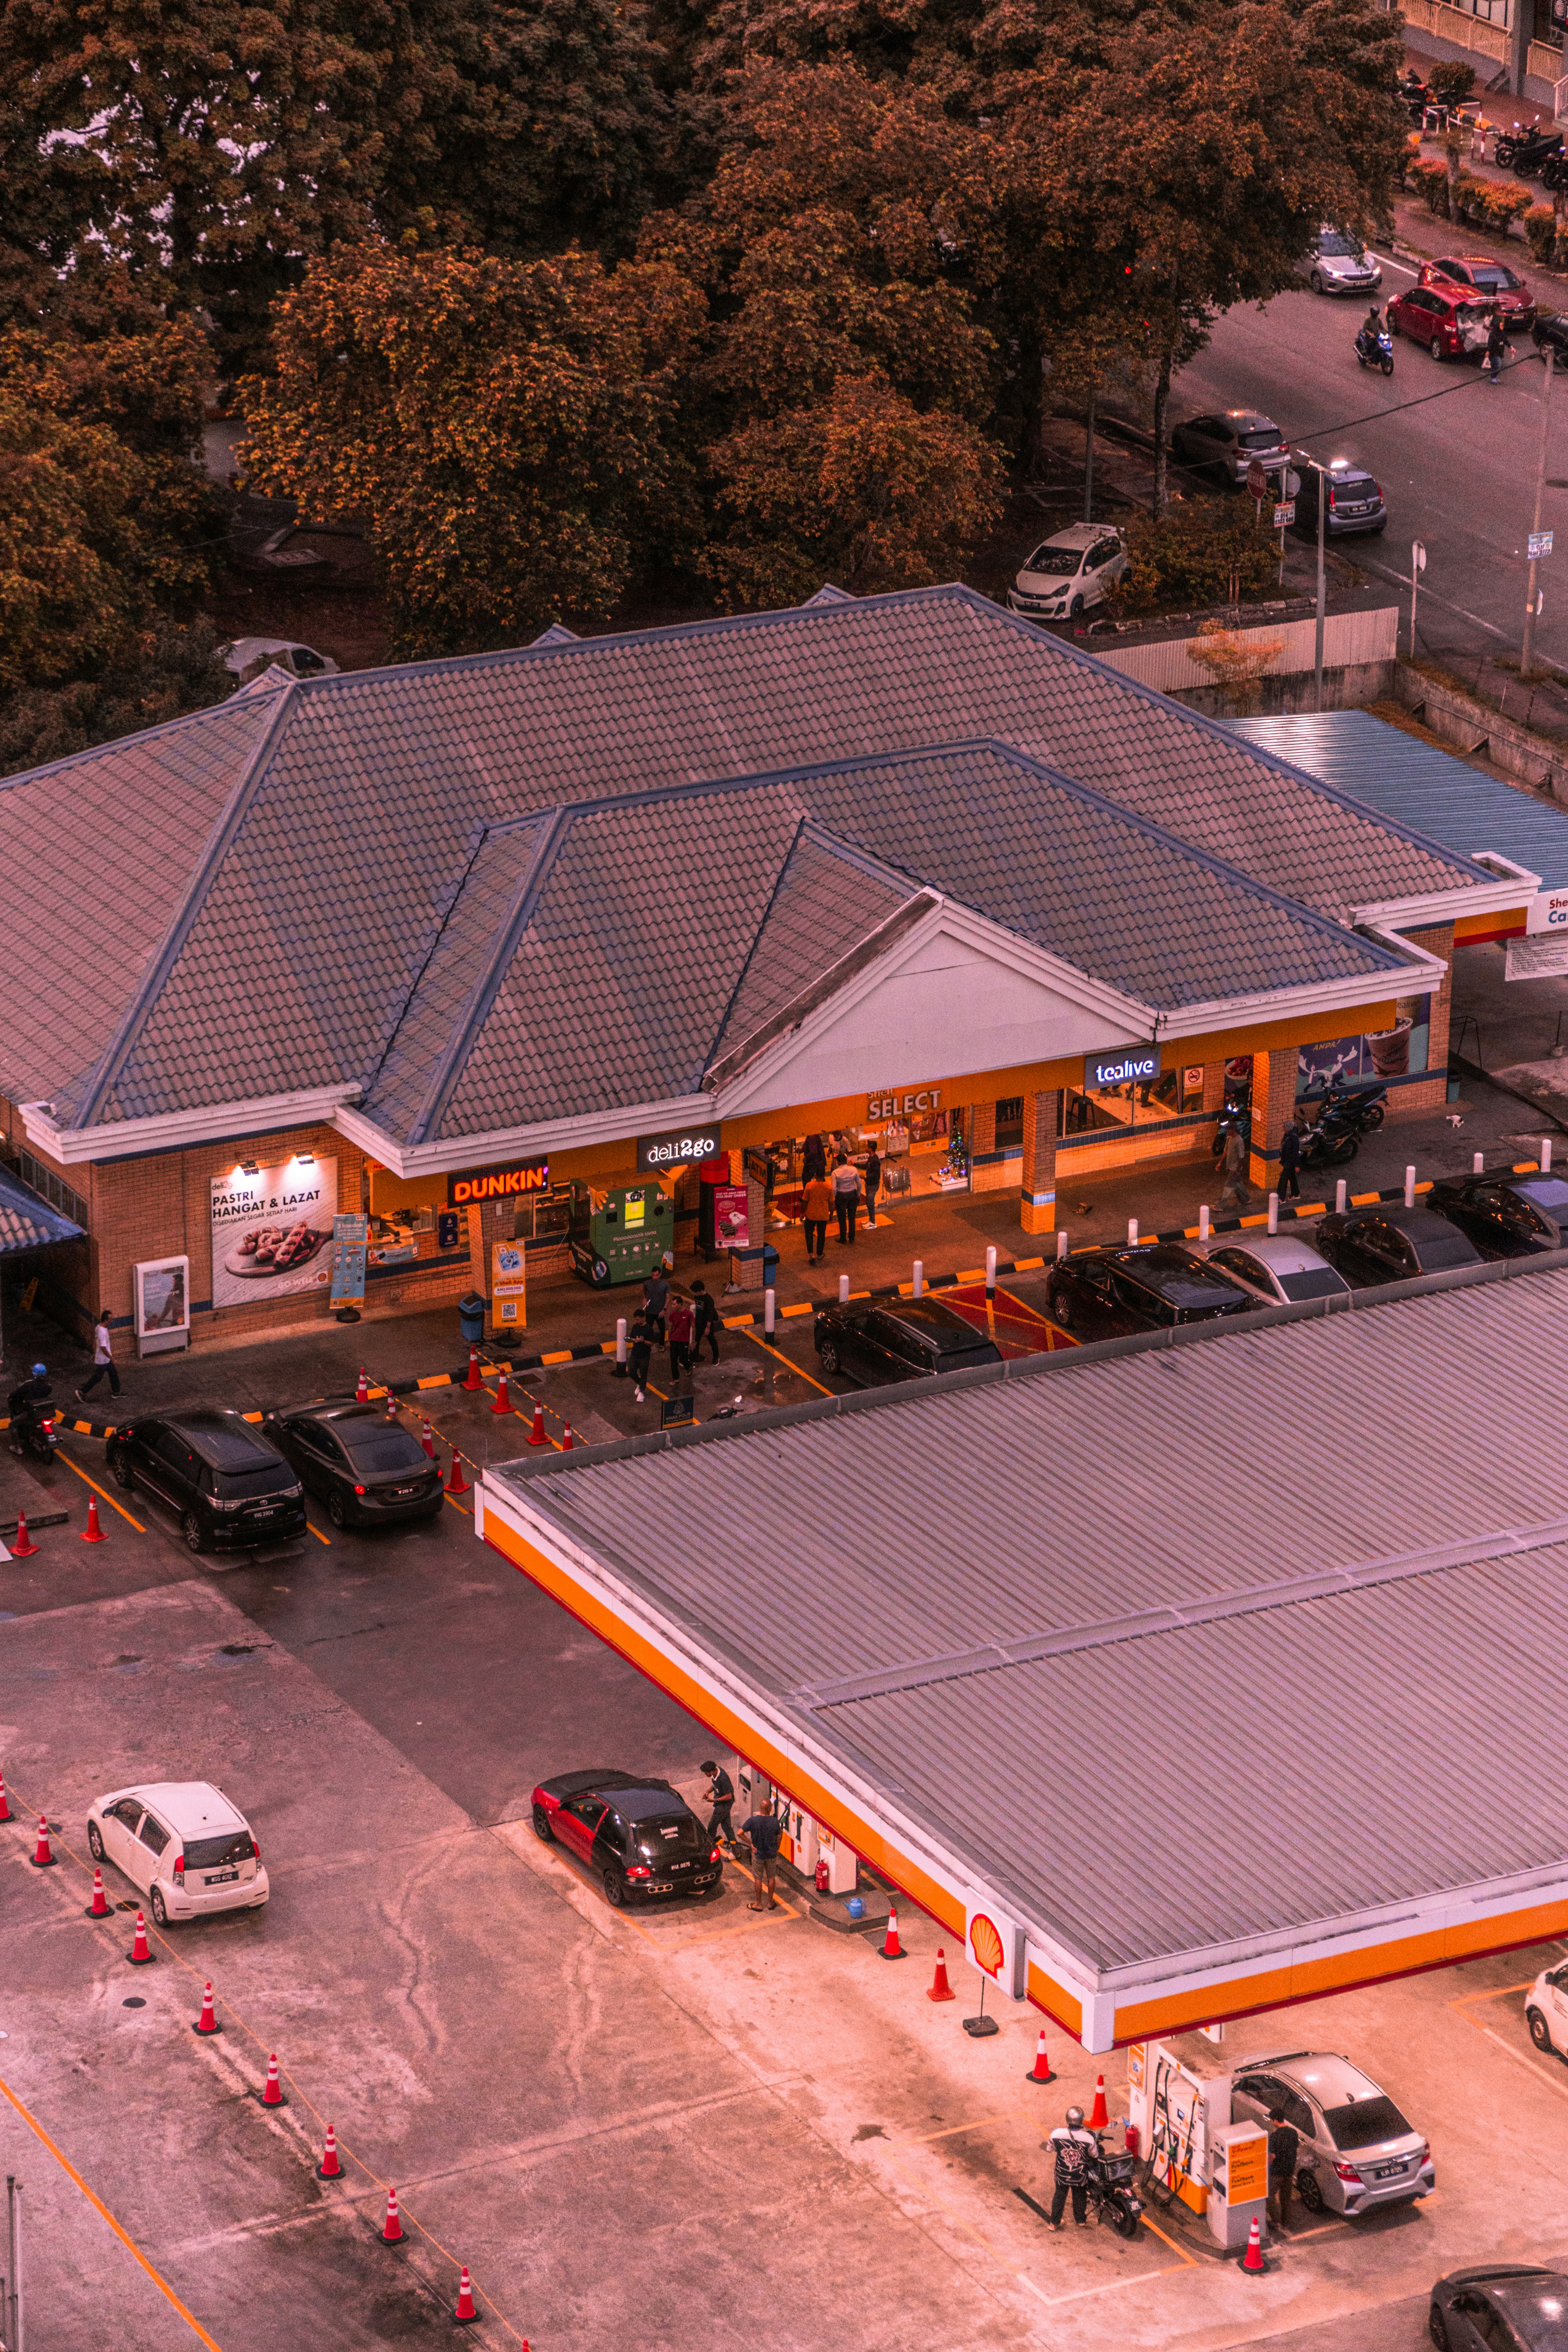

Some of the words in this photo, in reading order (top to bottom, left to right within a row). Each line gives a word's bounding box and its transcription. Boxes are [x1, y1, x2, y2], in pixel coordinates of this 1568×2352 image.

[1550, 898, 1568, 909] She
[1548, 910, 1568, 924] Ca
[1096, 1060, 1153, 1082] tealive
[868, 1089, 941, 1120] SELECT
[648, 1138, 715, 1162] deli2go
[751, 1161, 766, 1180] ATM
[212, 1200, 265, 1218] HANGAT
[269, 1198, 278, 1208] &
[283, 1190, 320, 1206] LAZAT
[213, 1191, 253, 1207] PASTRI
[213, 1216, 246, 1227] DISEDIAKAN
[278, 1280, 291, 1289] GO
